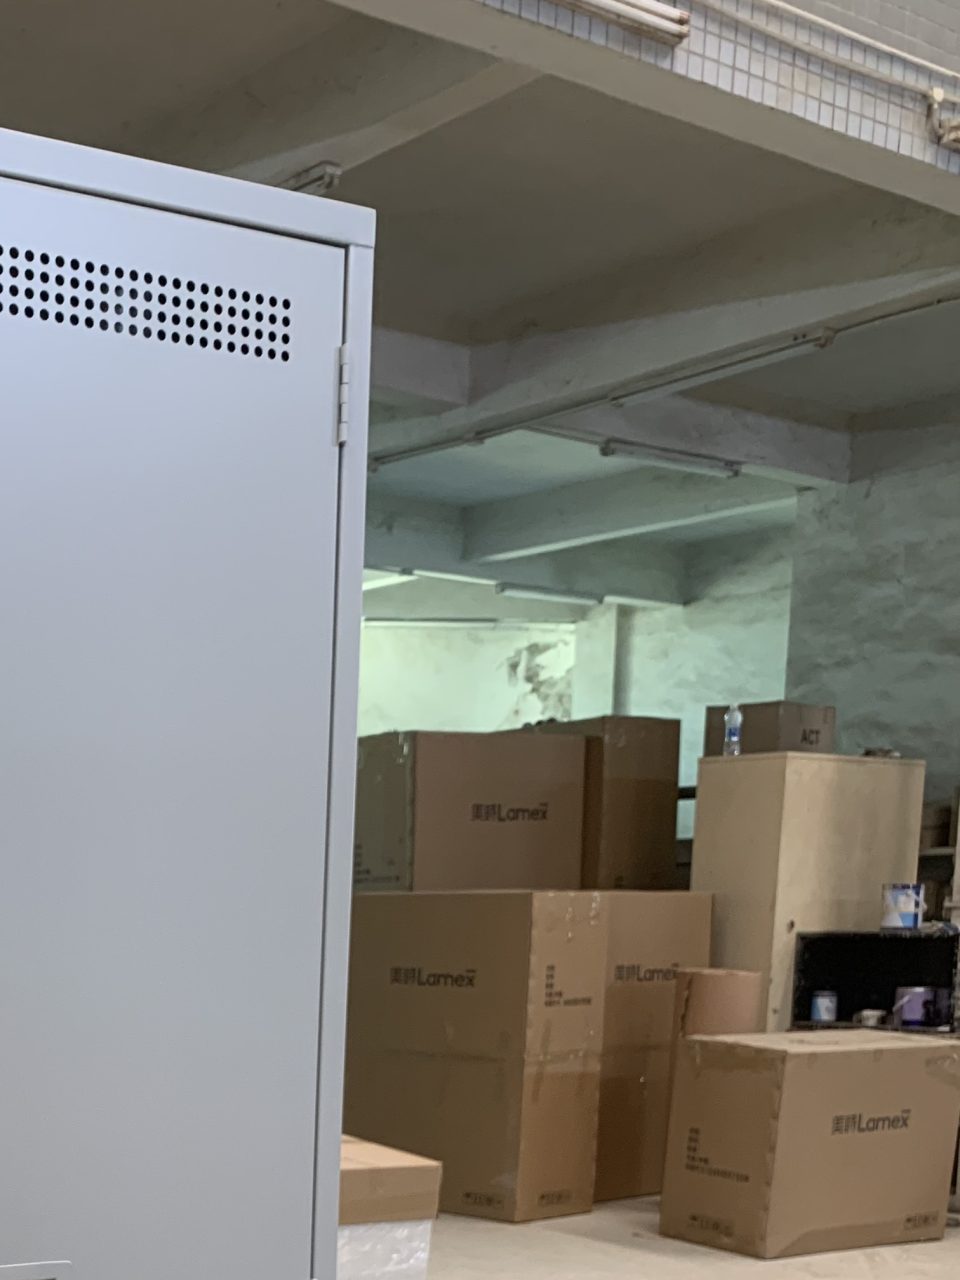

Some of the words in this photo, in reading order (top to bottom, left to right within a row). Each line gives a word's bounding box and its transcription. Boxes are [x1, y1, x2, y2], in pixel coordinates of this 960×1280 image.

[801, 728, 820, 745] ACT
[417, 967, 477, 988] Lamex
[857, 1108, 911, 1133] Lamex
